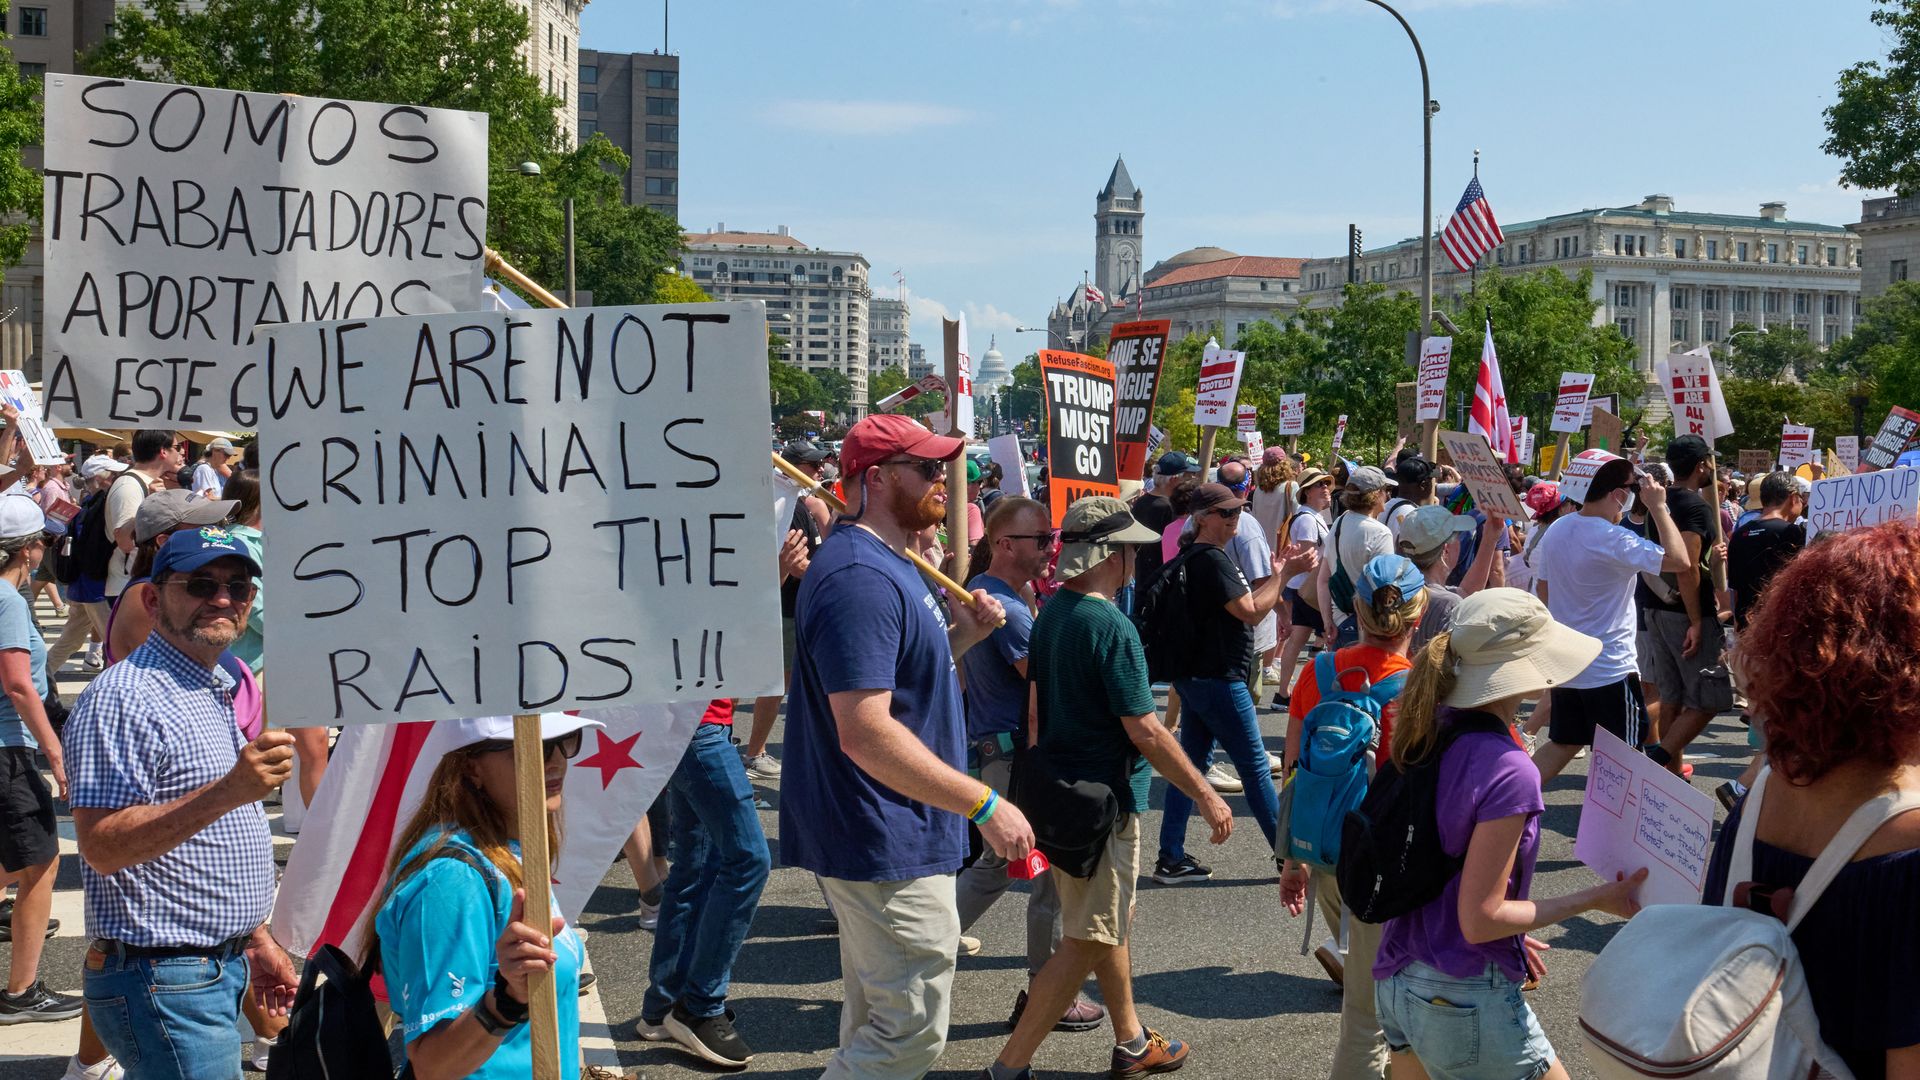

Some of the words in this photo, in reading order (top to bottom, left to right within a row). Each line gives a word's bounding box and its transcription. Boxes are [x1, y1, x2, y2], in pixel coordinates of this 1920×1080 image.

[81, 80, 439, 166] SOMOS
[44, 169, 486, 261] TRABAJADORES
[1046, 353, 1111, 377] RefuseFascism.org
[1140, 337, 1162, 366] SE
[267, 322, 368, 420] WE
[403, 321, 533, 411] ARE
[554, 313, 731, 404] NOT
[43, 355, 83, 422] A
[109, 357, 217, 422] ESTE
[1048, 372, 1114, 412] TRUMP
[1200, 379, 1231, 391] PROTEJA
[1682, 375, 1701, 388] WE
[1557, 396, 1584, 405] PROTEJA
[1683, 391, 1704, 403] ARE
[1060, 407, 1110, 445] MUST
[1685, 405, 1705, 420] ALL
[1689, 421, 1704, 435] DC
[1873, 430, 1907, 453] LARGUE
[1900, 420, 1917, 437] SE
[1075, 444, 1102, 477] GO
[1866, 446, 1895, 468] TRUMP
[1814, 474, 1886, 511] STAND
[1890, 469, 1918, 501] UP
[1809, 507, 1868, 539] SPEAK
[293, 527, 552, 618] STOP
[593, 513, 746, 592] THE
[1594, 754, 1626, 788] Protect
[1641, 807, 1665, 832] Protect
[1643, 787, 1668, 813] Protect
[1683, 825, 1707, 852] country
[1639, 824, 1665, 849] Protect
